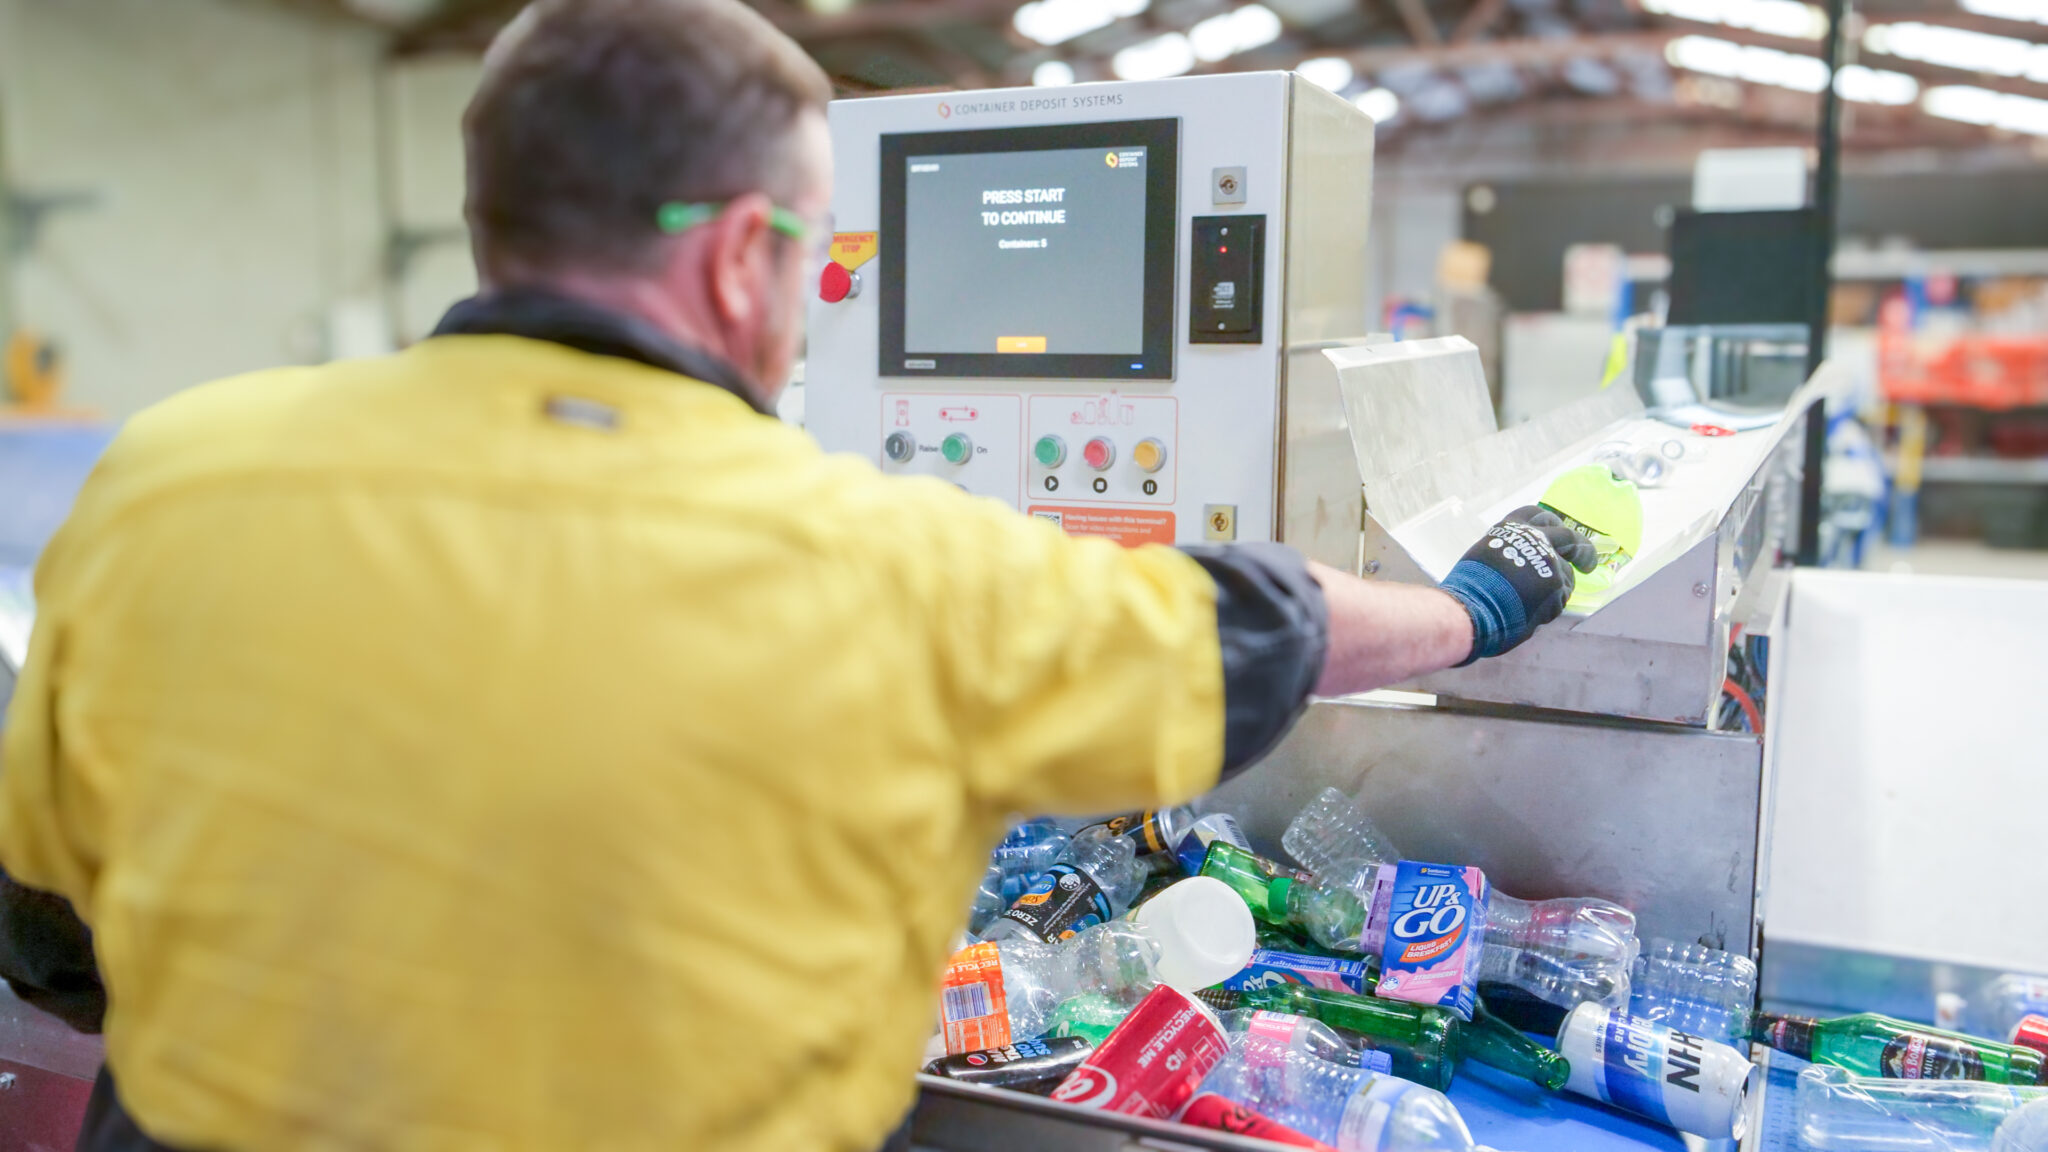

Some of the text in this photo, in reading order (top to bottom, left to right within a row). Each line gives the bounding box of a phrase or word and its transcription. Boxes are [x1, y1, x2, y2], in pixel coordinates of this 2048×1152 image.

[955, 94, 1124, 115] CONTAINER DEPOSIT SYSTEMS
[982, 187, 1066, 205] PRESS START
[981, 209, 1066, 226] TO CONTINUE
[833, 234, 873, 243] MERGENCY
[842, 244, 861, 253] STOP
[918, 444, 939, 453] Raise
[976, 446, 988, 455] On
[1064, 513, 1087, 523] Having
[1011, 908, 1039, 927] ZERO
[1393, 904, 1467, 938] GO
[1406, 937, 1452, 958] BREAKFAST
[1410, 941, 1437, 951] LIQUID
[957, 959, 999, 973] RECYCLE
[1152, 1006, 1197, 1052] RECYCLE
[1016, 1043, 1038, 1058] NO
[1136, 1048, 1158, 1068] ME
